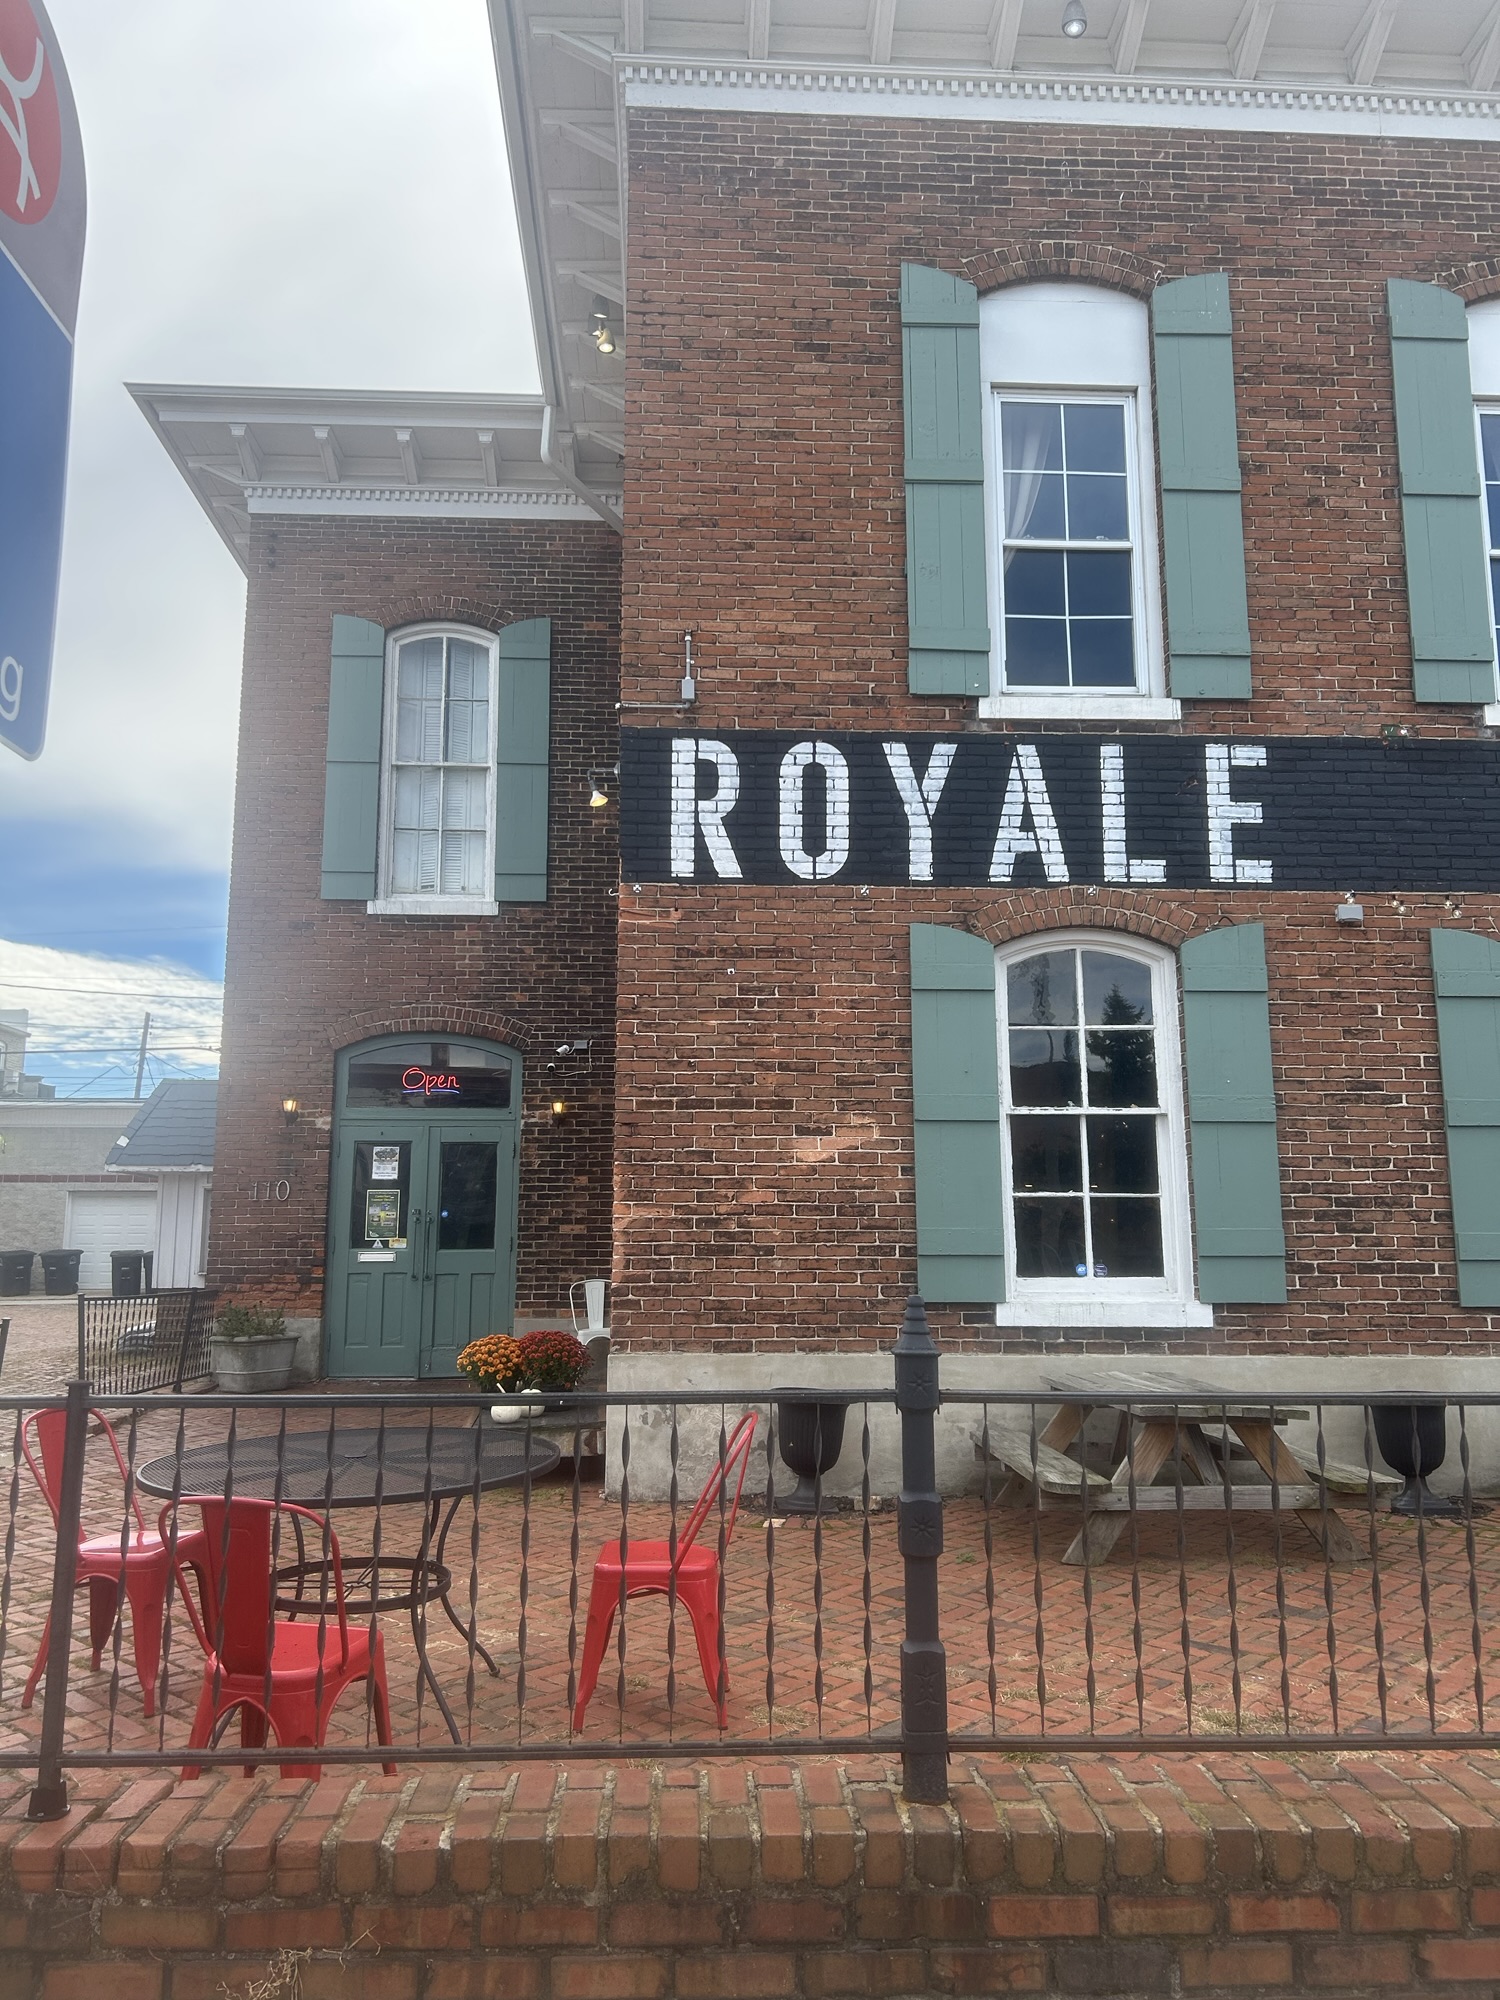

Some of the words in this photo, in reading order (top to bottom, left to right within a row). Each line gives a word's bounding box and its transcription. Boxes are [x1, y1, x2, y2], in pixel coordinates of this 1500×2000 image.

[670, 738, 1273, 884] ROYALE
[402, 1067, 460, 1095] Open
[252, 1180, 290, 1201] 110
